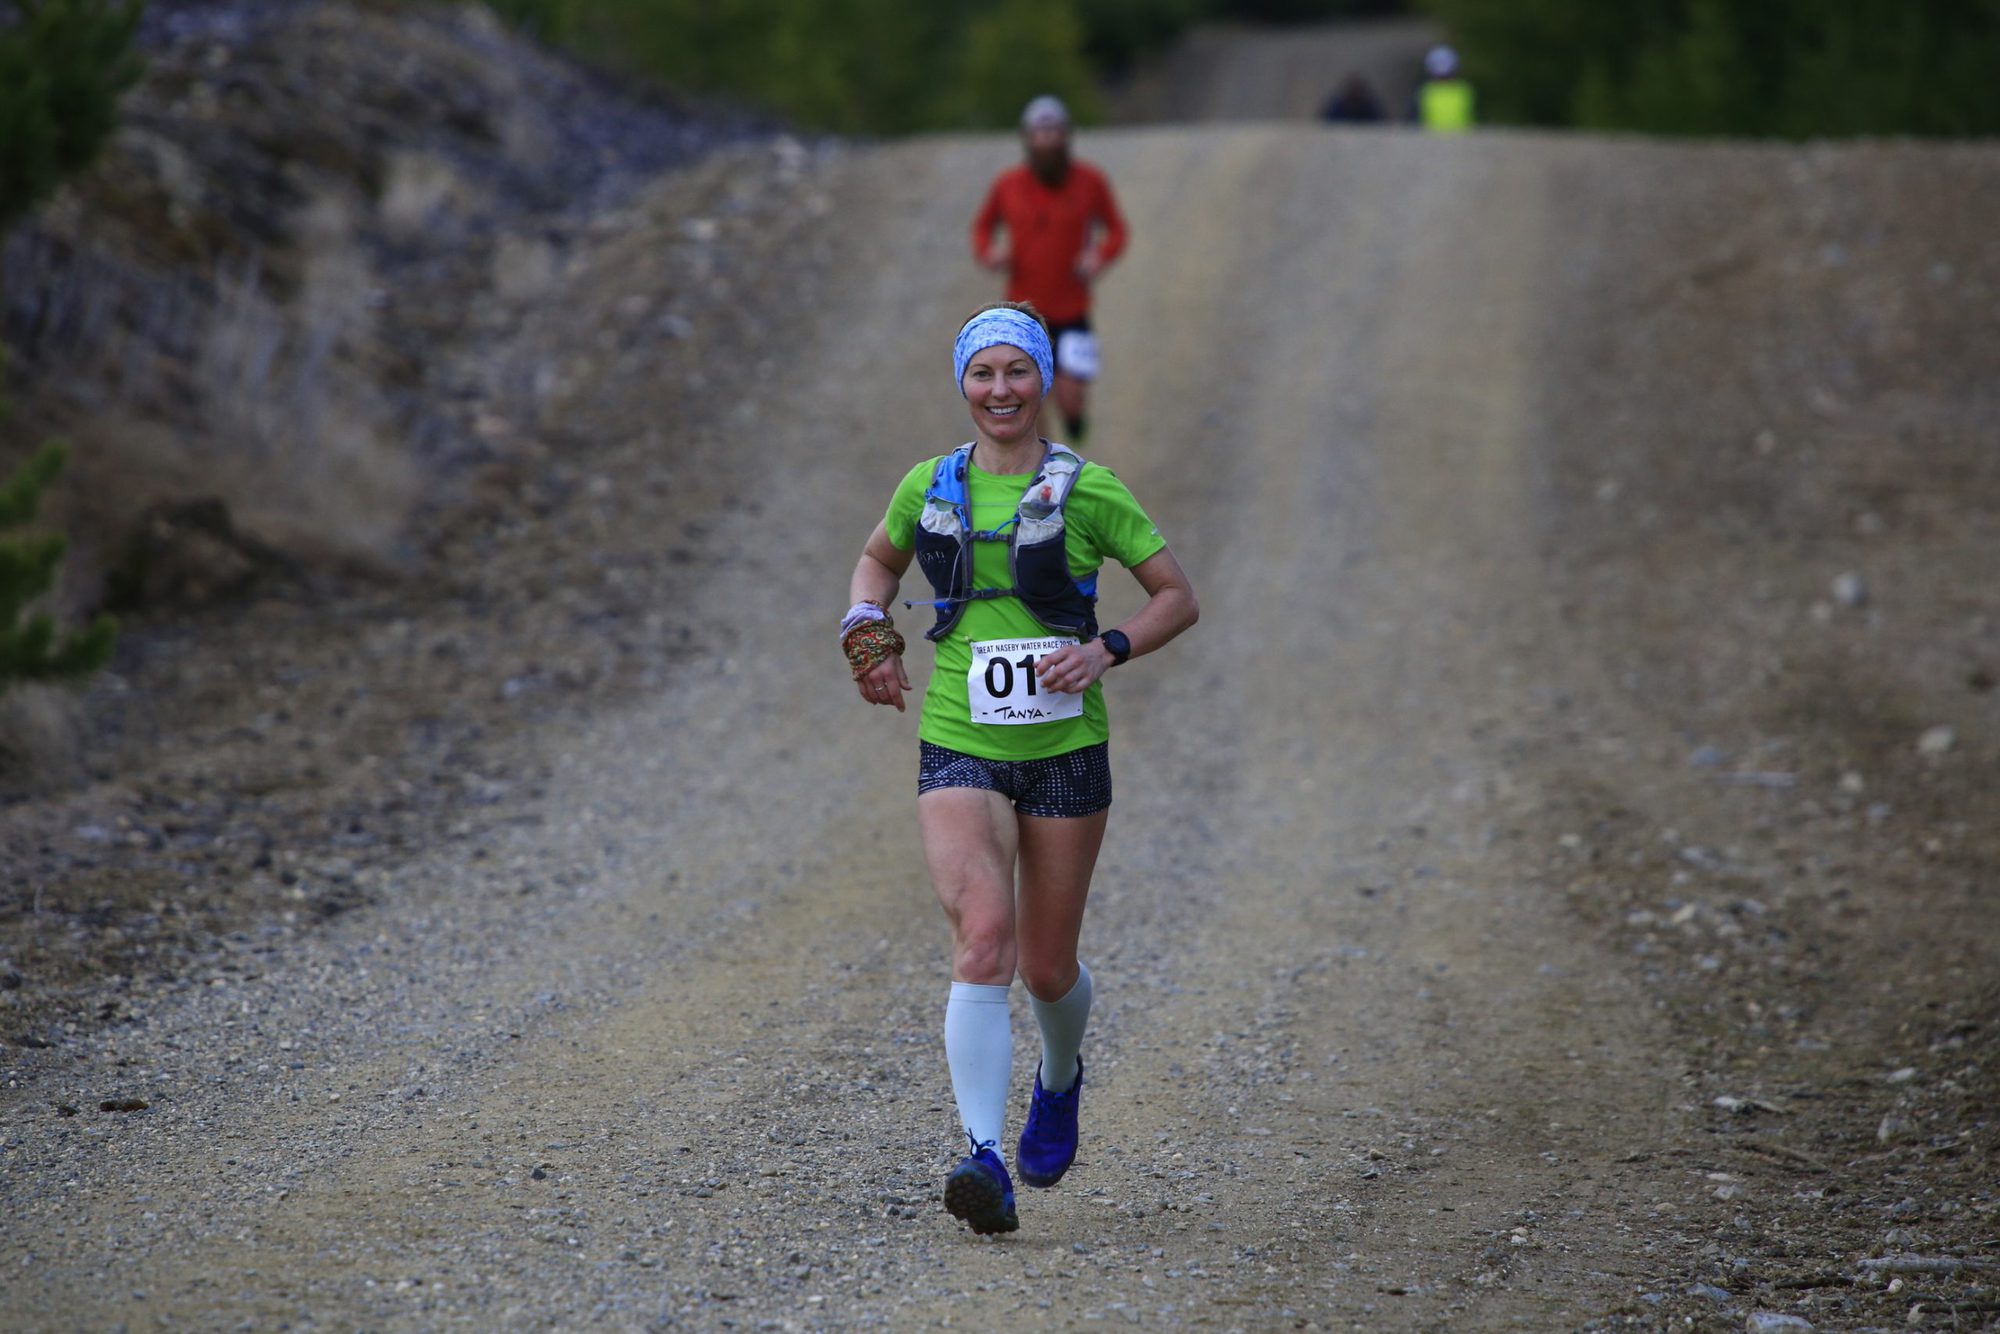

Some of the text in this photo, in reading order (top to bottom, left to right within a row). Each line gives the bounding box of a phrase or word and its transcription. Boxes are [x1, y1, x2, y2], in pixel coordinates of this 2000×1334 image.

[996, 643, 1020, 652] NASEBY
[1021, 641, 1042, 650] WATER
[1043, 640, 1059, 649] RACE
[985, 654, 1051, 698] 01
